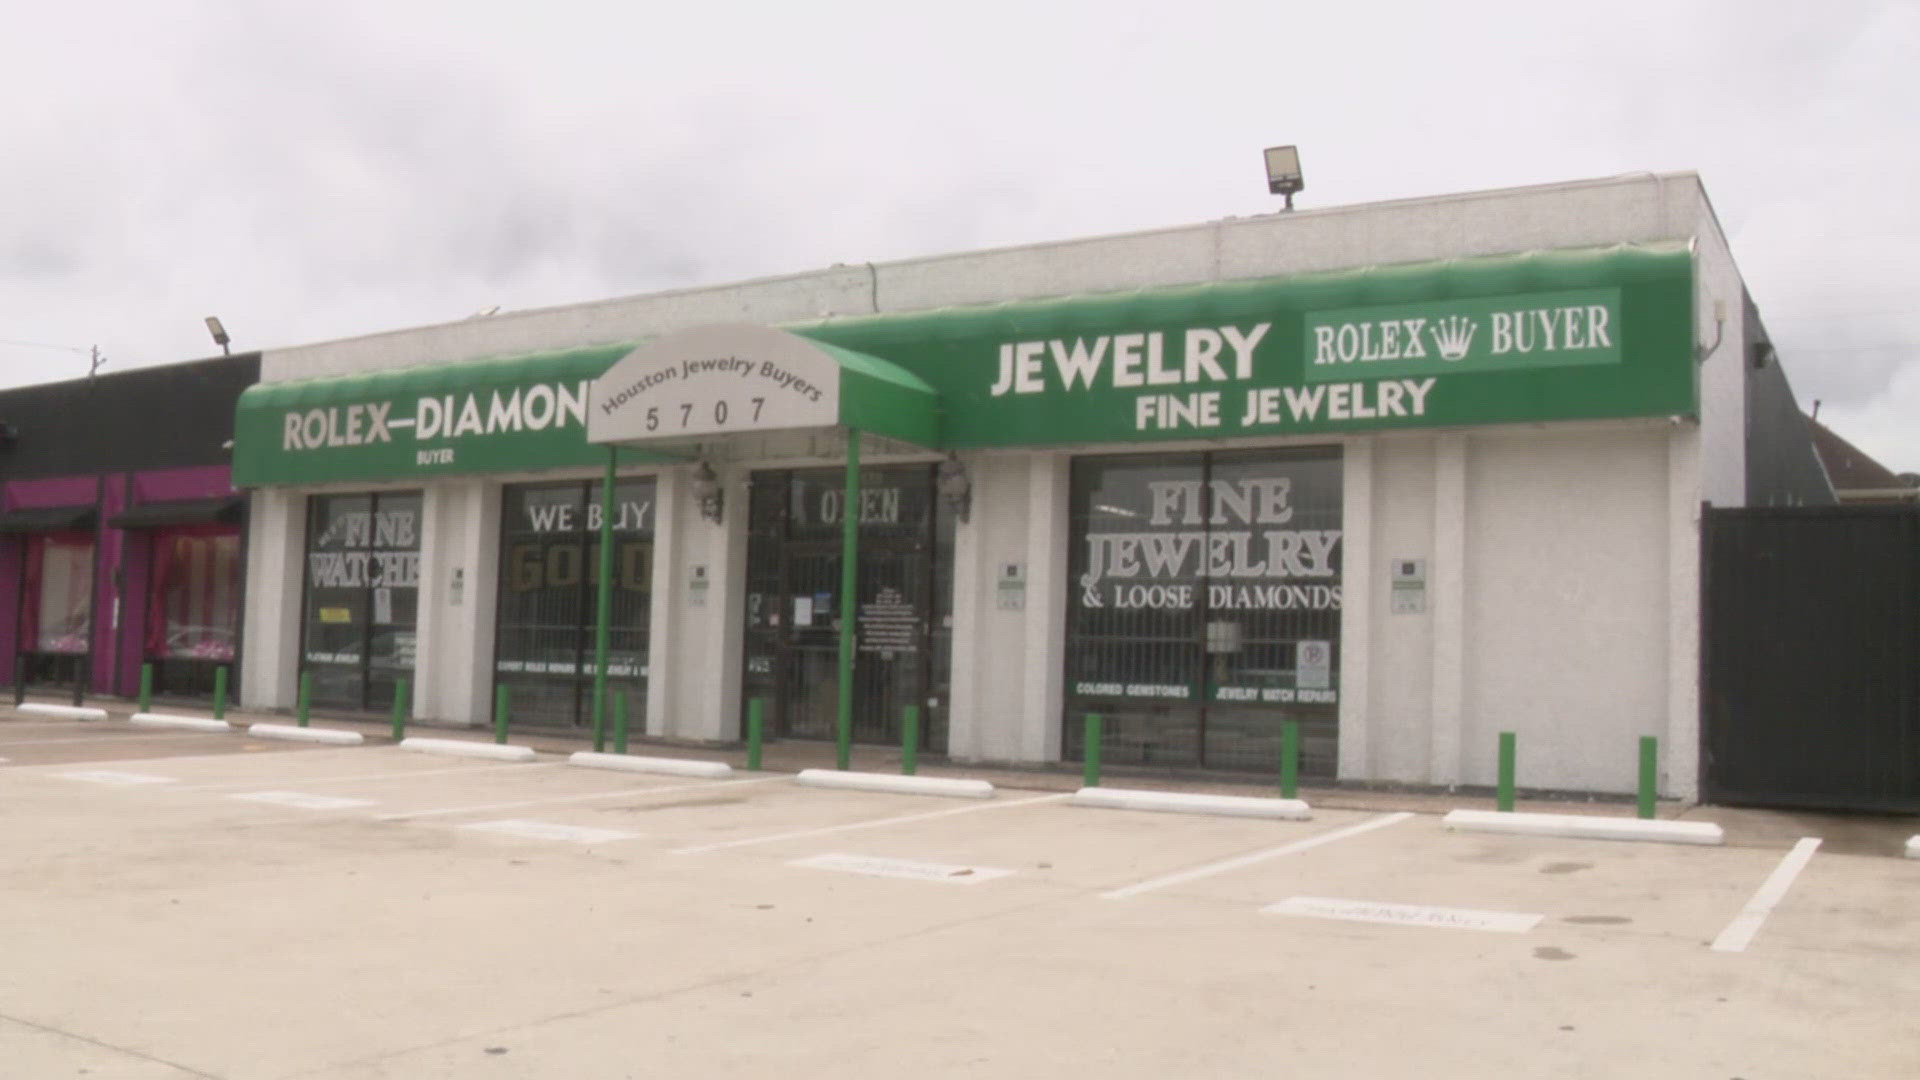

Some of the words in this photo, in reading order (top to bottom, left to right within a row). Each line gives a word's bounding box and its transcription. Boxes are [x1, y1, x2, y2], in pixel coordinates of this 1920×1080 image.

[1314, 318, 1427, 365] ROLEX
[1490, 305, 1612, 355] BUYER
[991, 322, 1272, 396] JEWELRY
[602, 365, 678, 415] Houston
[682, 356, 756, 380] Jewelry
[759, 361, 823, 402] Buyers
[1136, 391, 1221, 430] FINE
[1241, 378, 1436, 427] JEWELRY
[416, 449, 454, 466] BUYER
[529, 504, 573, 532] WE
[821, 488, 899, 524] OEN
[1149, 477, 1293, 525] FINE
[343, 511, 415, 547] FINE
[1080, 530, 1343, 588] JEWELRY
[1083, 586, 1104, 608] &
[1114, 585, 1193, 609] LOOSE
[1208, 584, 1343, 610] DIAMONDS
[1077, 682, 1123, 696] COLORED
[1127, 683, 1190, 699] GEMSTONES
[1216, 686, 1259, 700] JEWELRY
